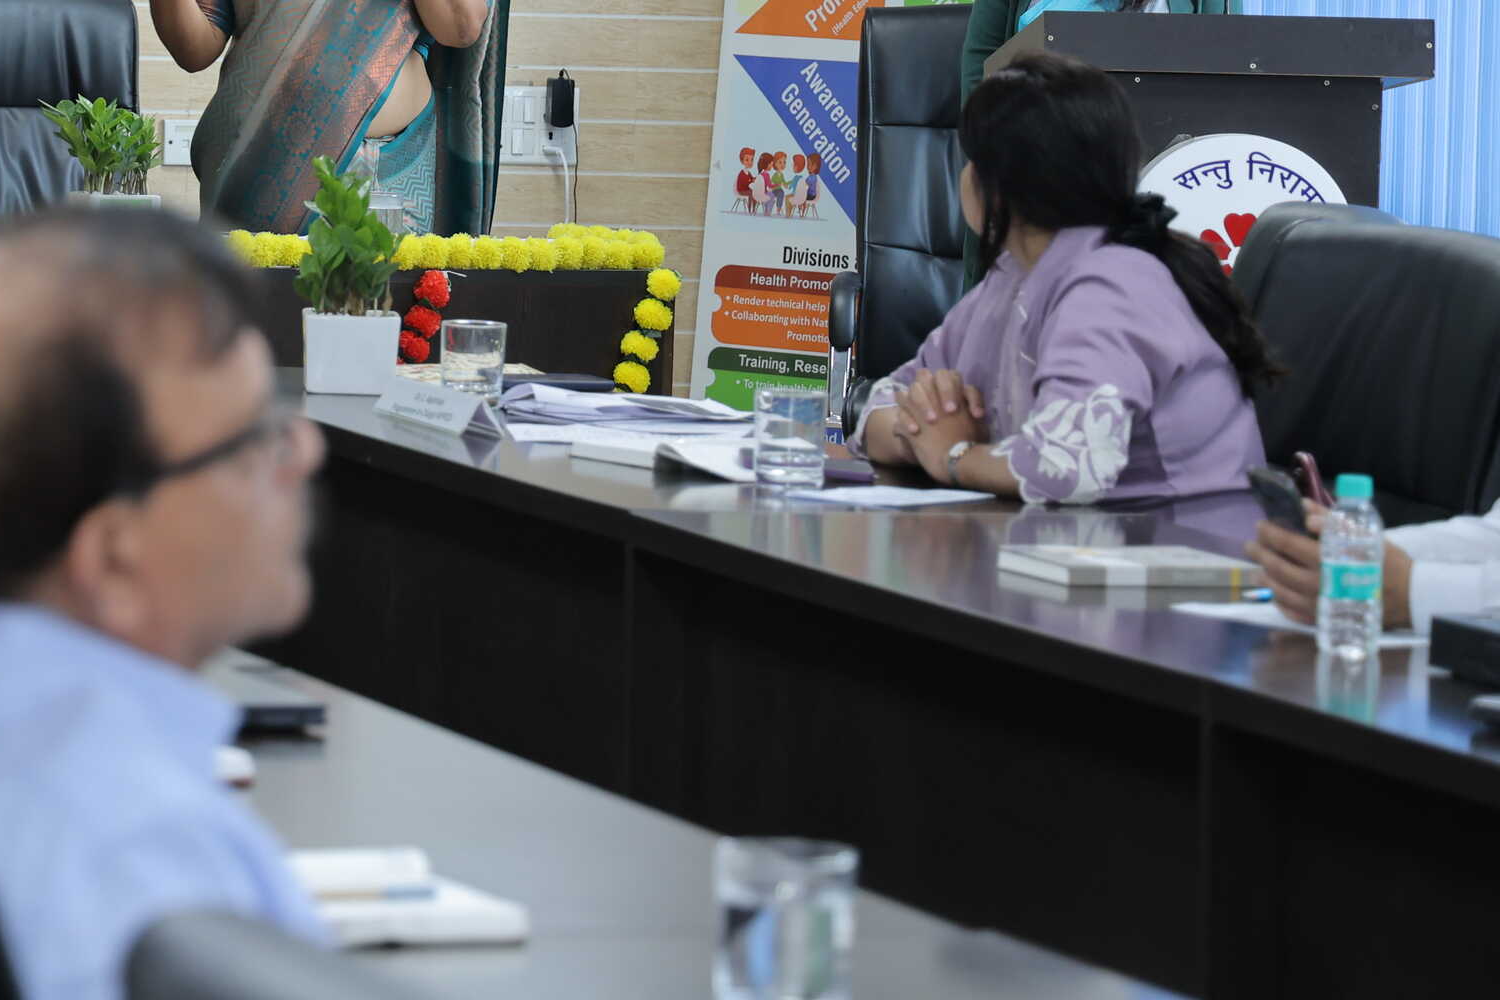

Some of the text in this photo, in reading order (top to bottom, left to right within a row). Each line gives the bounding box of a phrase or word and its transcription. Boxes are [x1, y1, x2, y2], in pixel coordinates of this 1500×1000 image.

[781, 83, 851, 184] Generation
[1172, 159, 1233, 190] सन्तु
[783, 246, 849, 269] Divisions
[750, 272, 787, 287] Health
[732, 294, 826, 313] Render technical help
[731, 310, 789, 325] Collaborating
[790, 315, 810, 326] with
[738, 353, 790, 373] Training,
[743, 378, 754, 389] To
